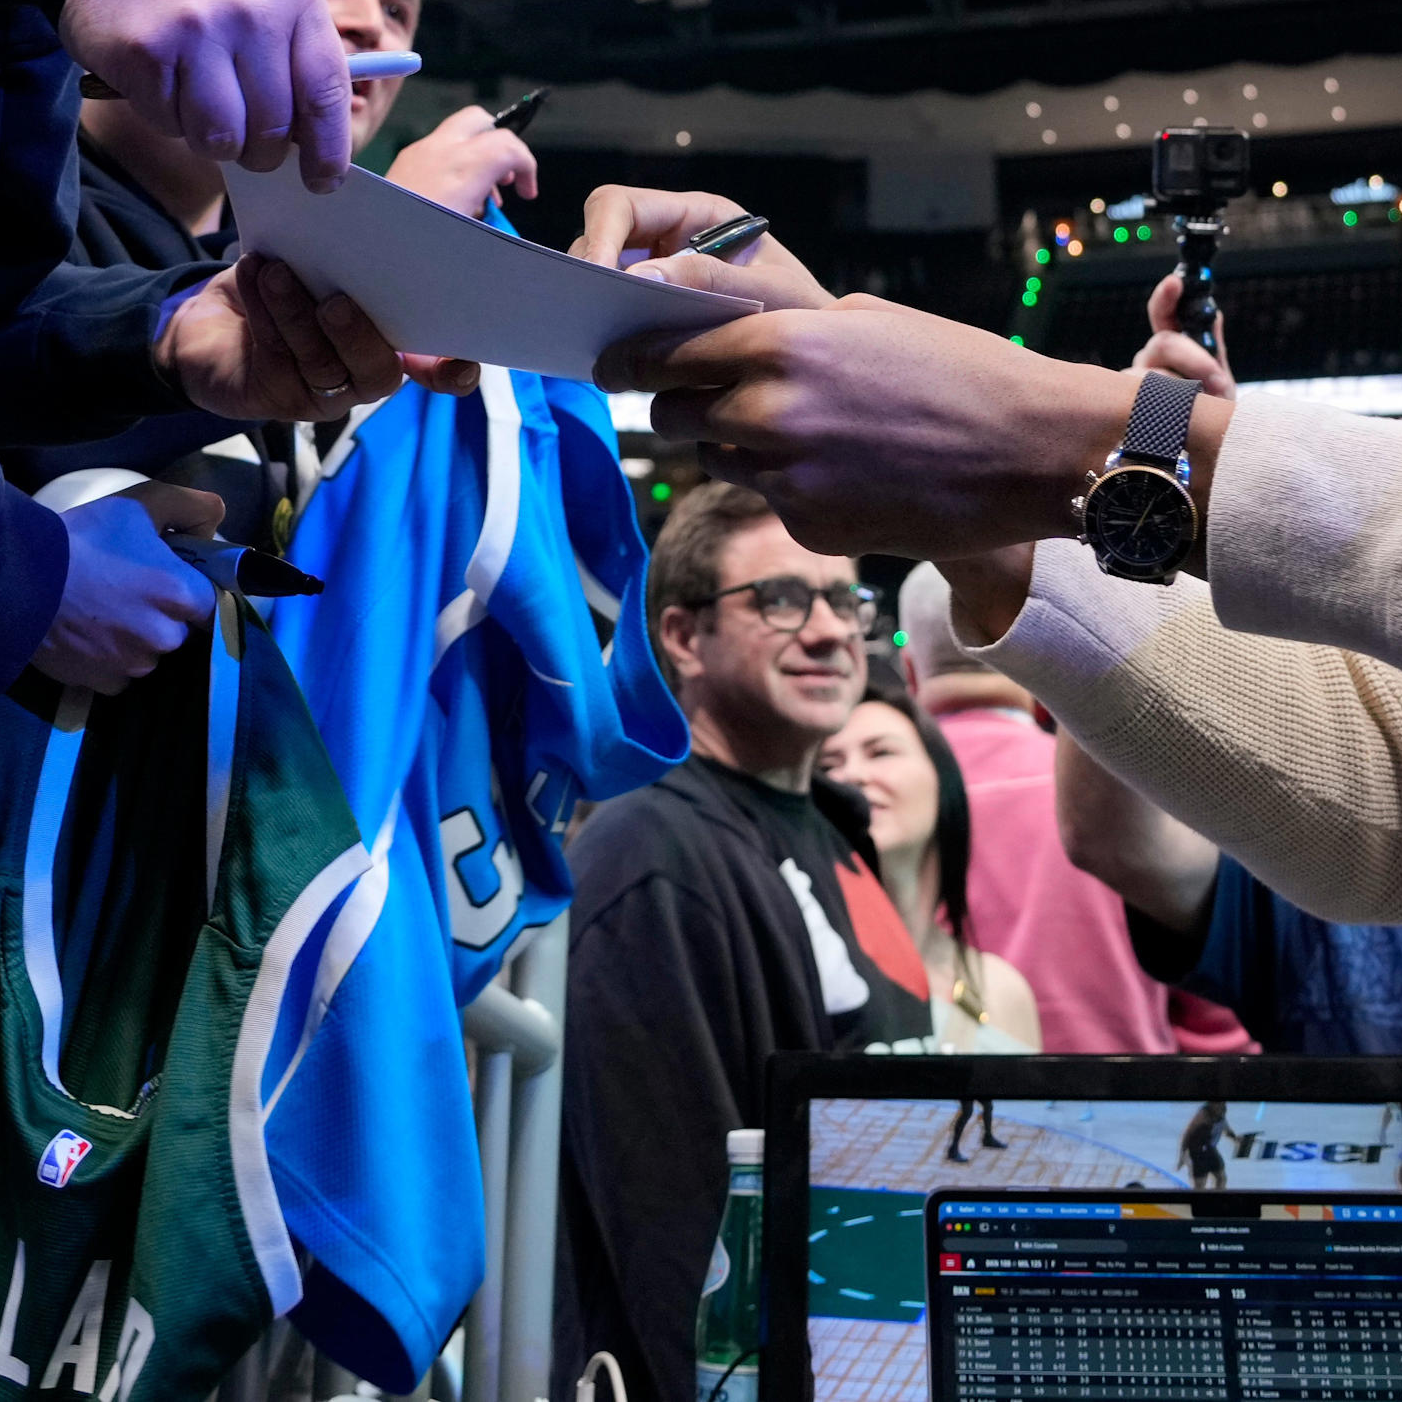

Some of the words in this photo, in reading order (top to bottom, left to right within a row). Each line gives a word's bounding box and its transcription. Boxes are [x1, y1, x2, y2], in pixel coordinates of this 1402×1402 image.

[953, 1286, 970, 1296] BKN
[1205, 1288, 1220, 1299] 108
[1231, 1288, 1246, 1299] 125
